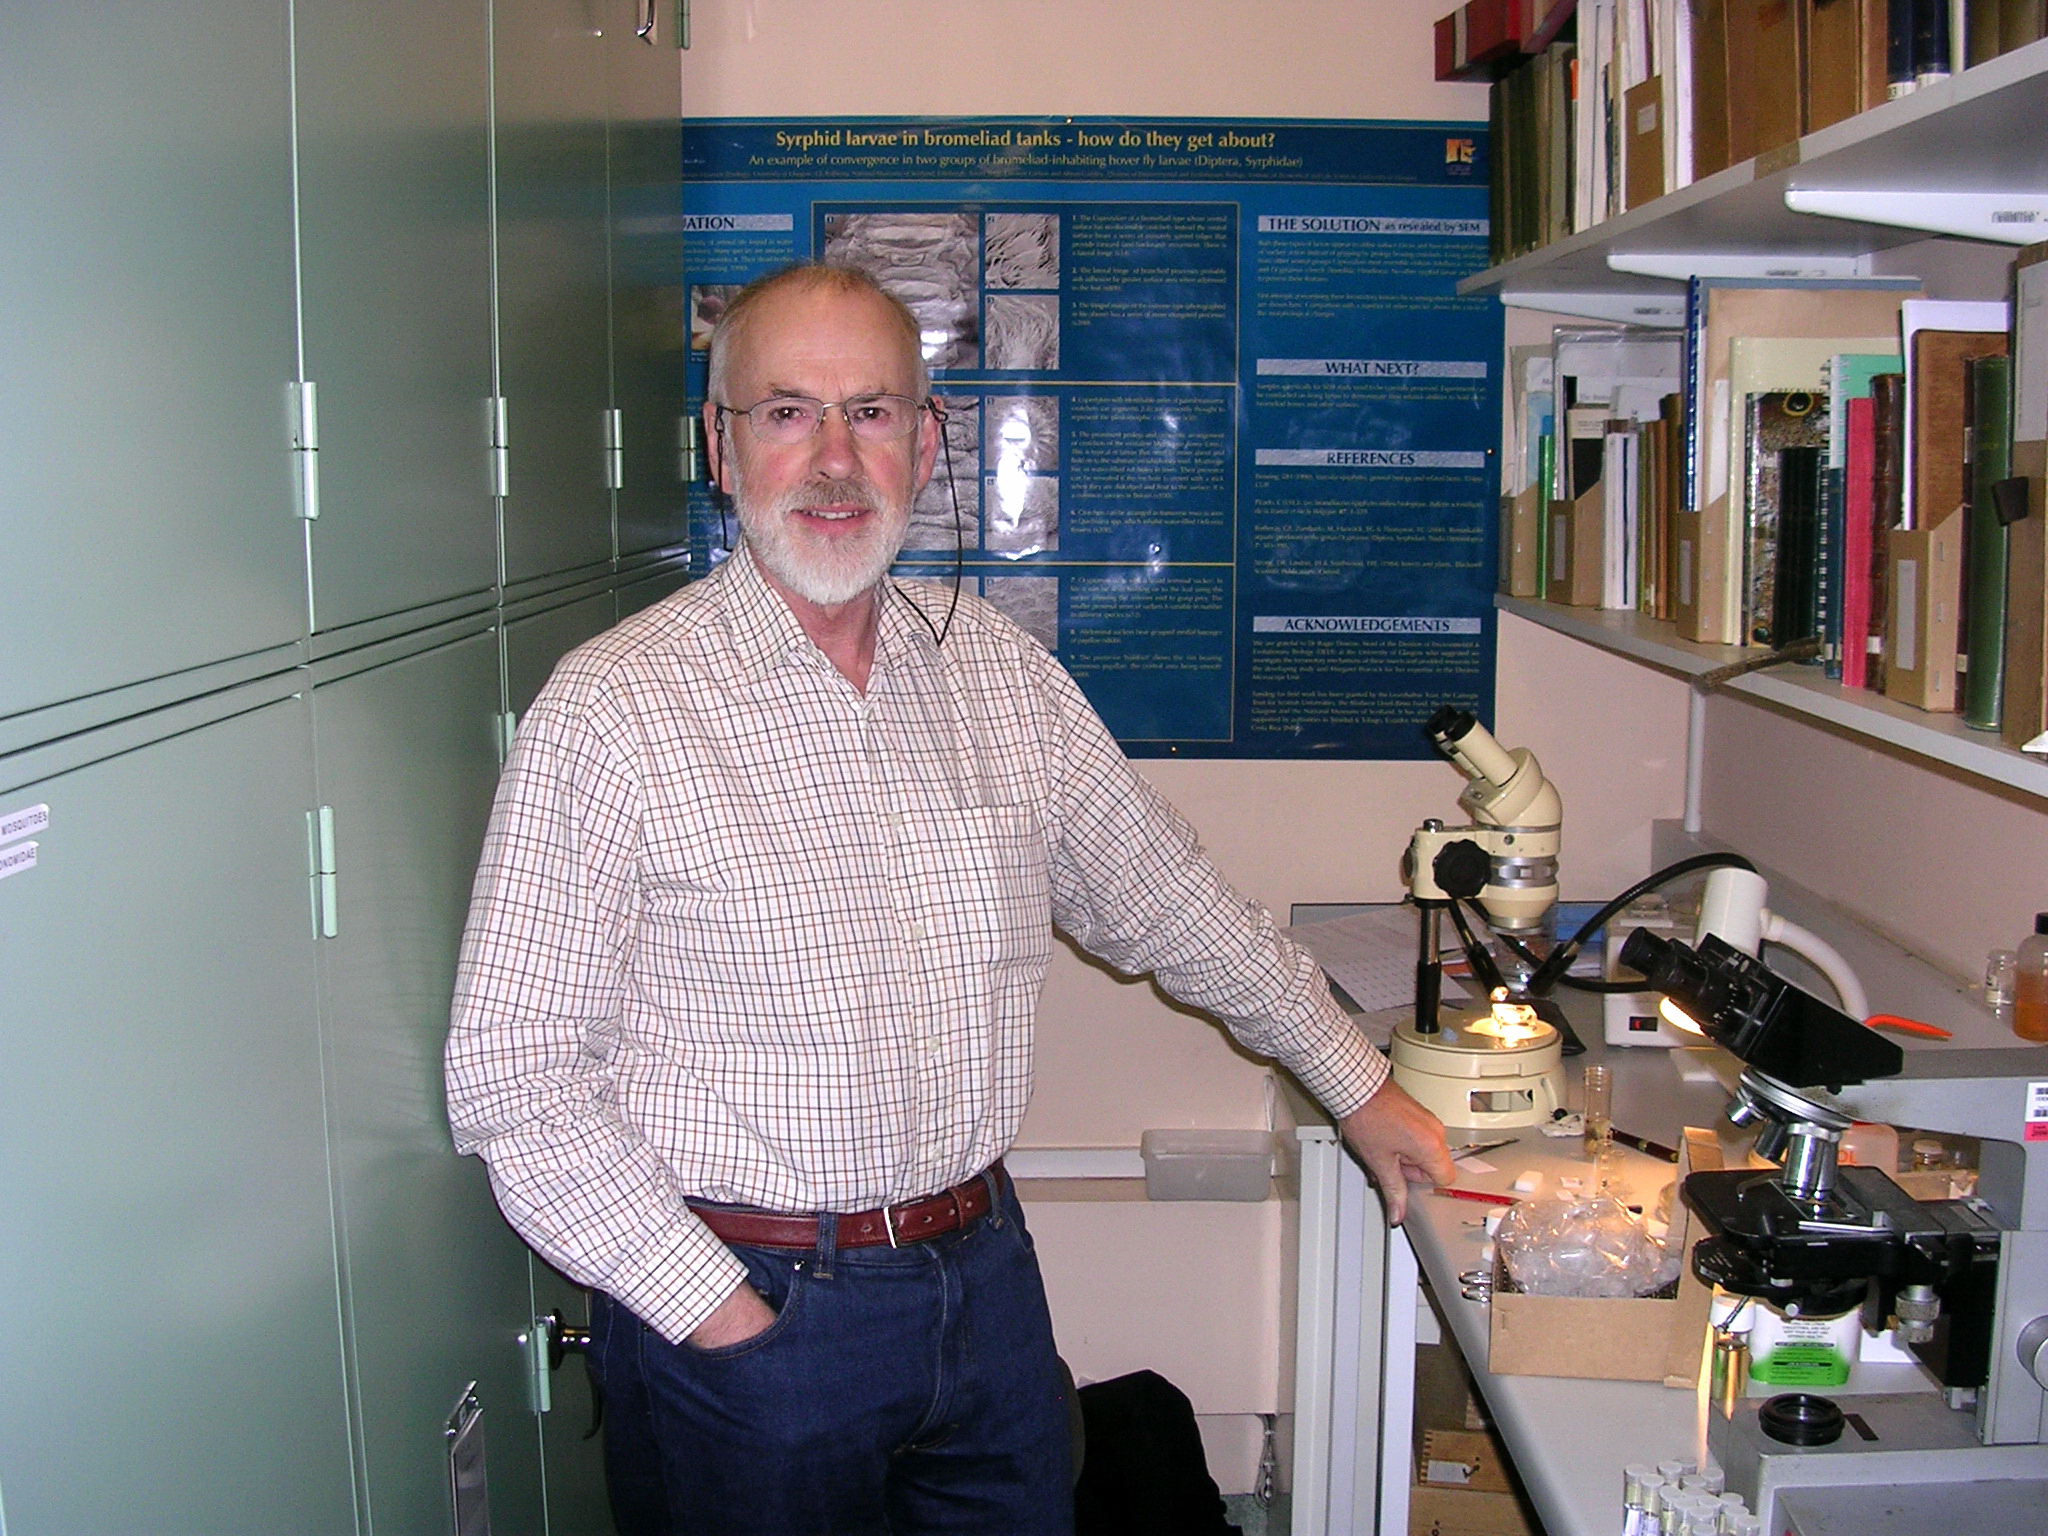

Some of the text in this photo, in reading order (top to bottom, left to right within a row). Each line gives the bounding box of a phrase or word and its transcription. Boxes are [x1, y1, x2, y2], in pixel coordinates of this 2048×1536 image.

[775, 129, 841, 149] Syrphid
[846, 130, 898, 147] larvae
[903, 131, 918, 147] in
[924, 129, 1011, 147] bromeliad
[1016, 130, 1061, 147] tanks
[1078, 131, 1114, 147] how
[1119, 131, 1141, 147] do
[1146, 131, 1182, 152] they
[1187, 134, 1213, 152] get
[1218, 131, 1276, 148] about?
[748, 154, 1303, 171] An example of convergence in two groups of bromeliad-inhabiting hover fly larvae (Diptera, Syrphidae)
[683, 216, 734, 229] ATION
[1269, 218, 1298, 231] THE
[1301, 218, 1381, 232] SOLUTION
[1398, 221, 1441, 232] revealed
[1444, 222, 1456, 234] by
[1325, 362, 1420, 376] WHAT NEXT?
[1326, 452, 1416, 465] REFERENCES
[1284, 619, 1451, 632] ACKNOWLEDGEMENTS
[1, 810, 48, 836] MOSQUITOES
